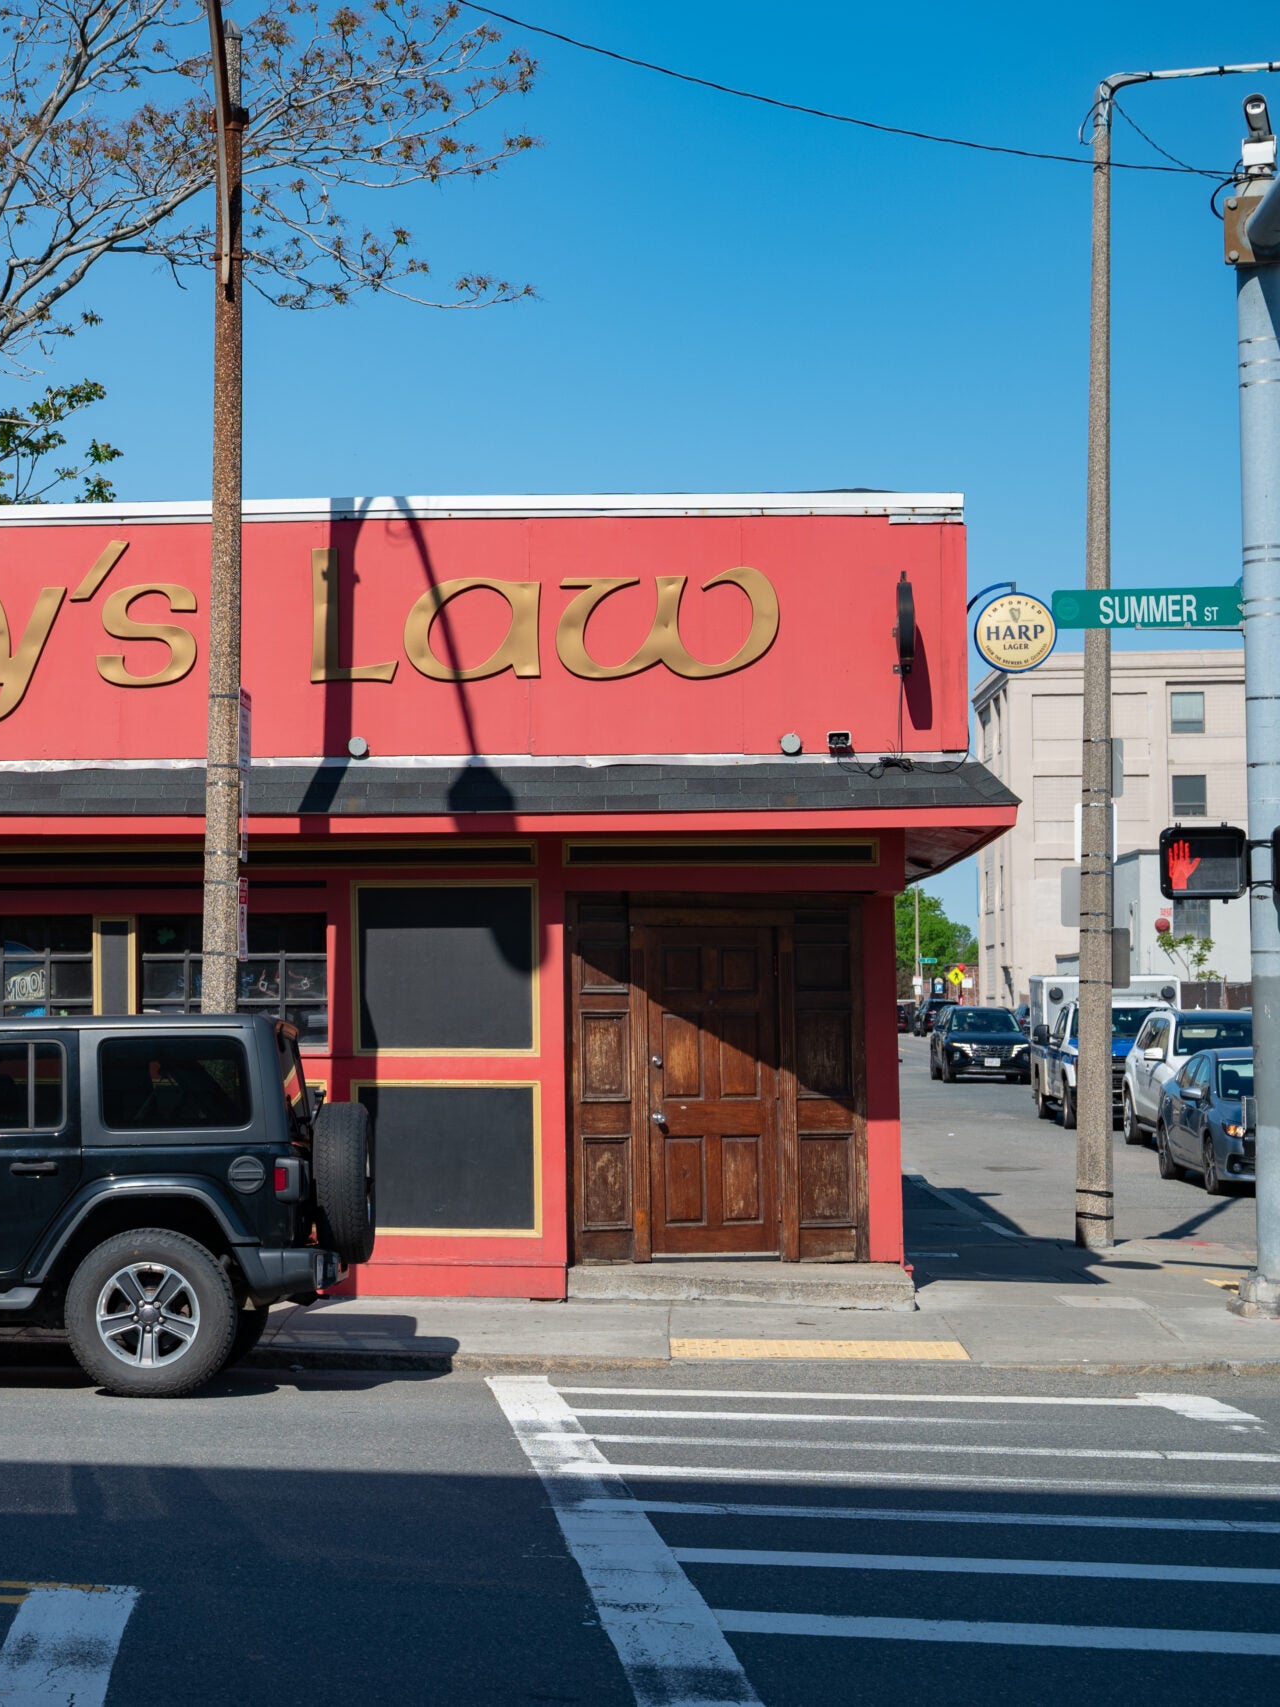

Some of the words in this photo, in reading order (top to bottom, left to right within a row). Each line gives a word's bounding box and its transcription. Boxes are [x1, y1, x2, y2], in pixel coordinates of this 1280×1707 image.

[310, 547, 780, 682] Law
[988, 600, 1042, 618] IMPORTED
[1099, 594, 1197, 624] SUMMER
[1204, 606, 1219, 621] ST
[986, 624, 1045, 641] HARP
[1003, 643, 1030, 651] LAGER
